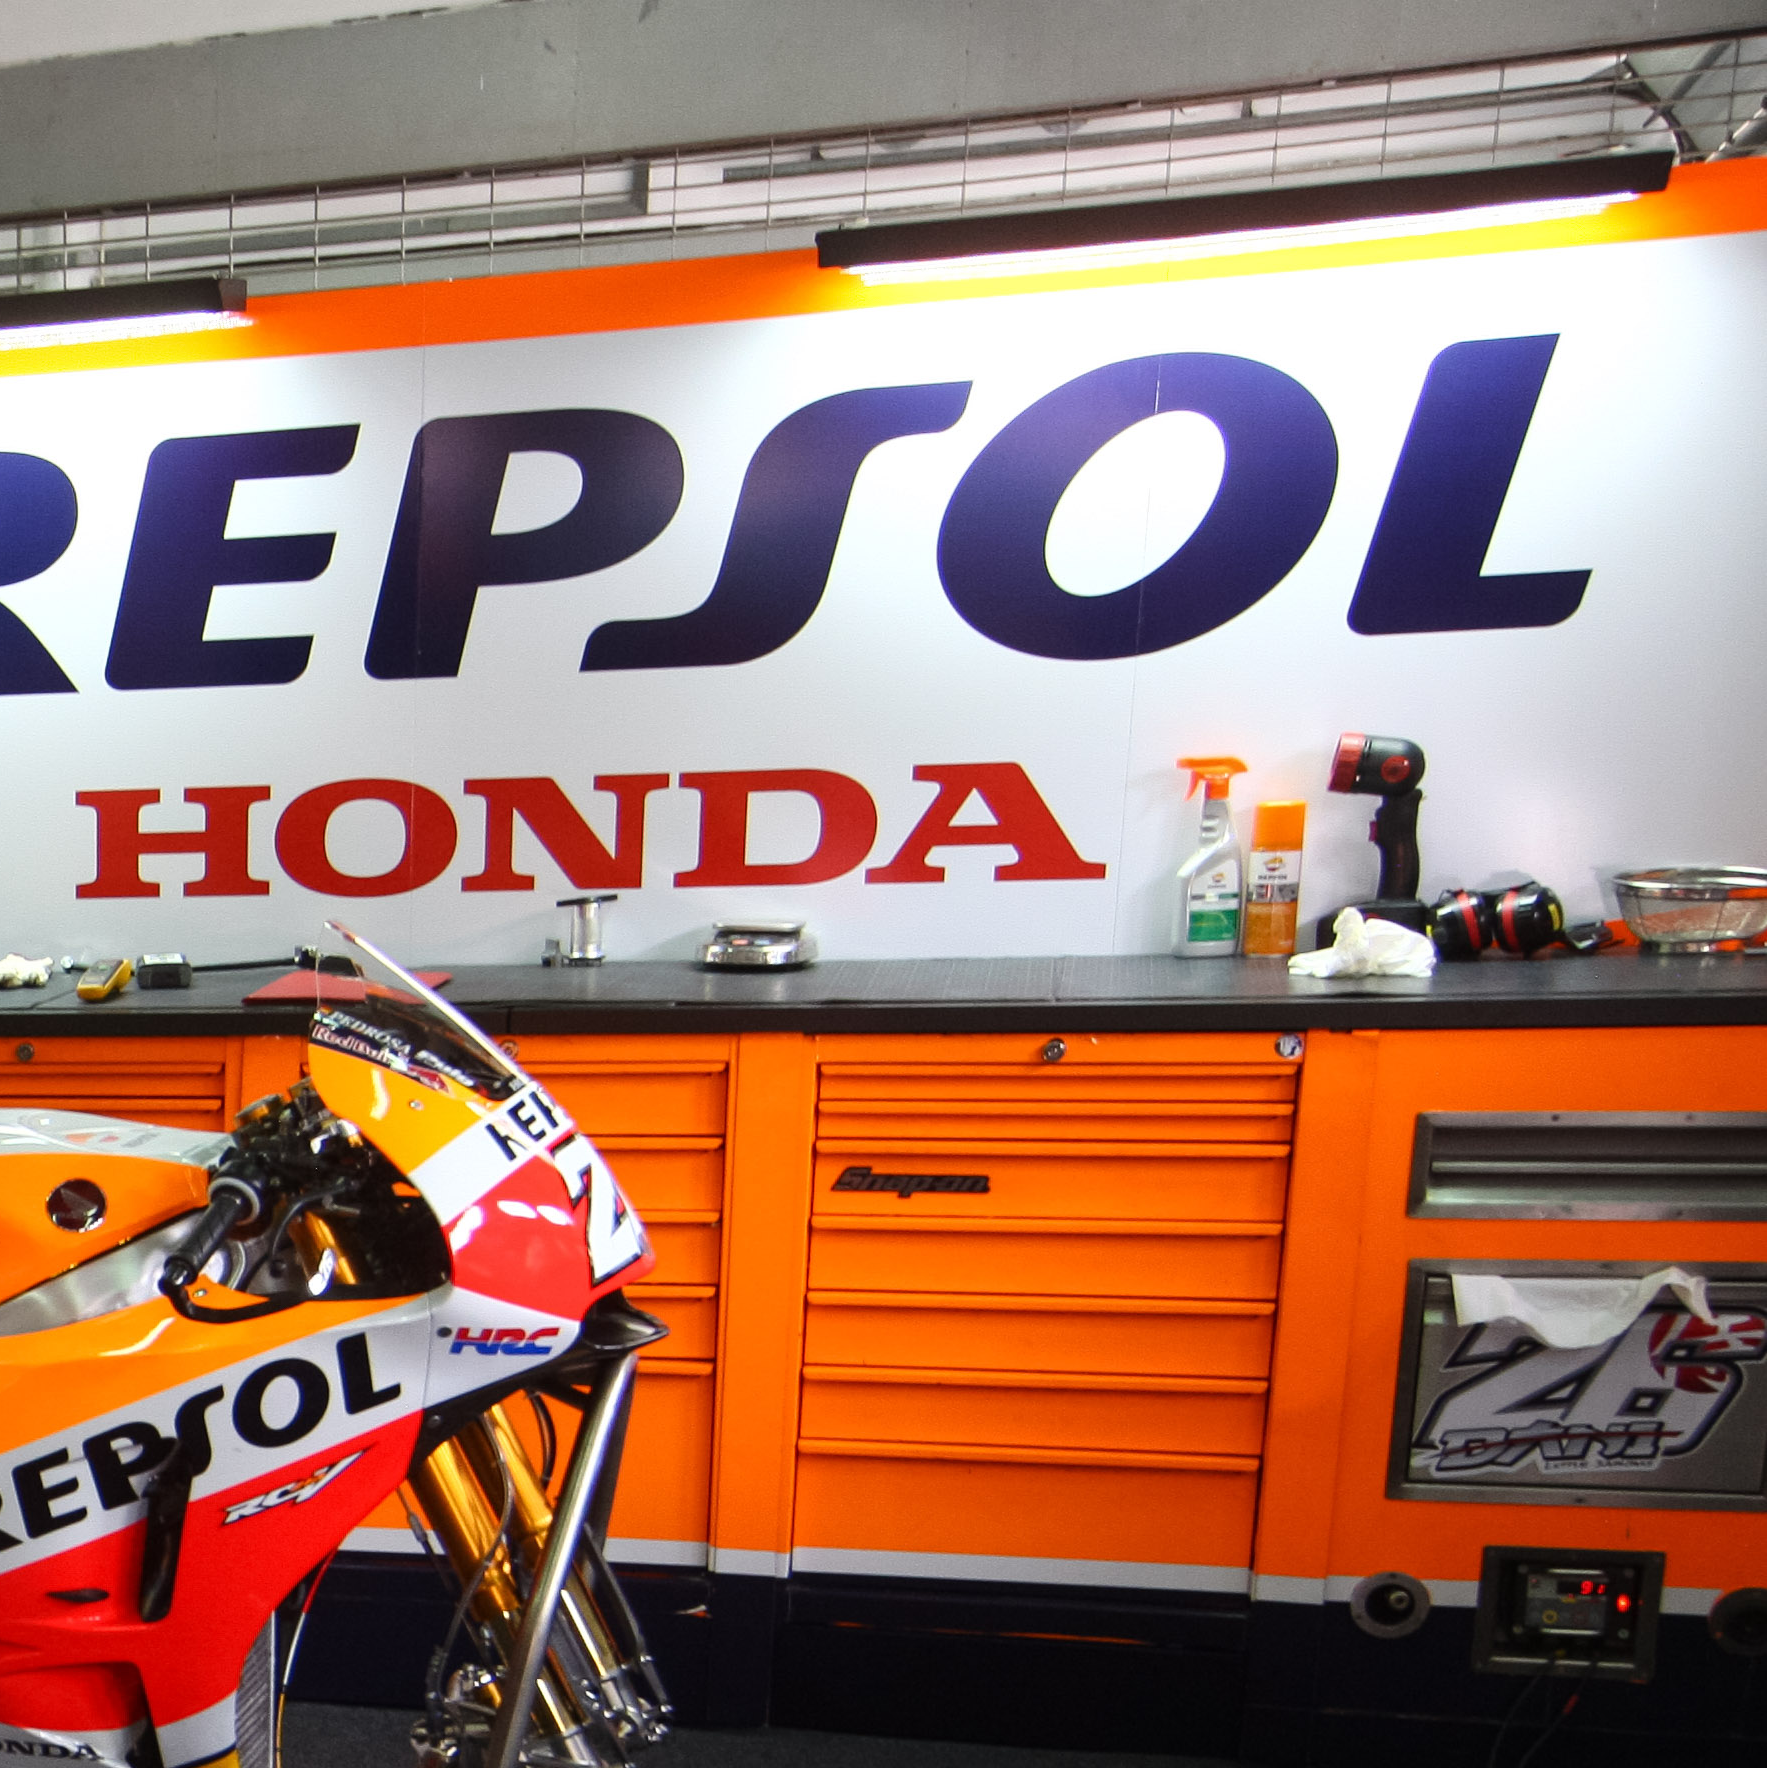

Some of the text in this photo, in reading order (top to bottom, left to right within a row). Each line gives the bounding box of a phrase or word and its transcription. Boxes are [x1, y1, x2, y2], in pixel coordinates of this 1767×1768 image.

[72, 760, 1107, 901] HONDA
[830, 1166, 991, 1199] Snap-on
[450, 1327, 560, 1355] HRC
